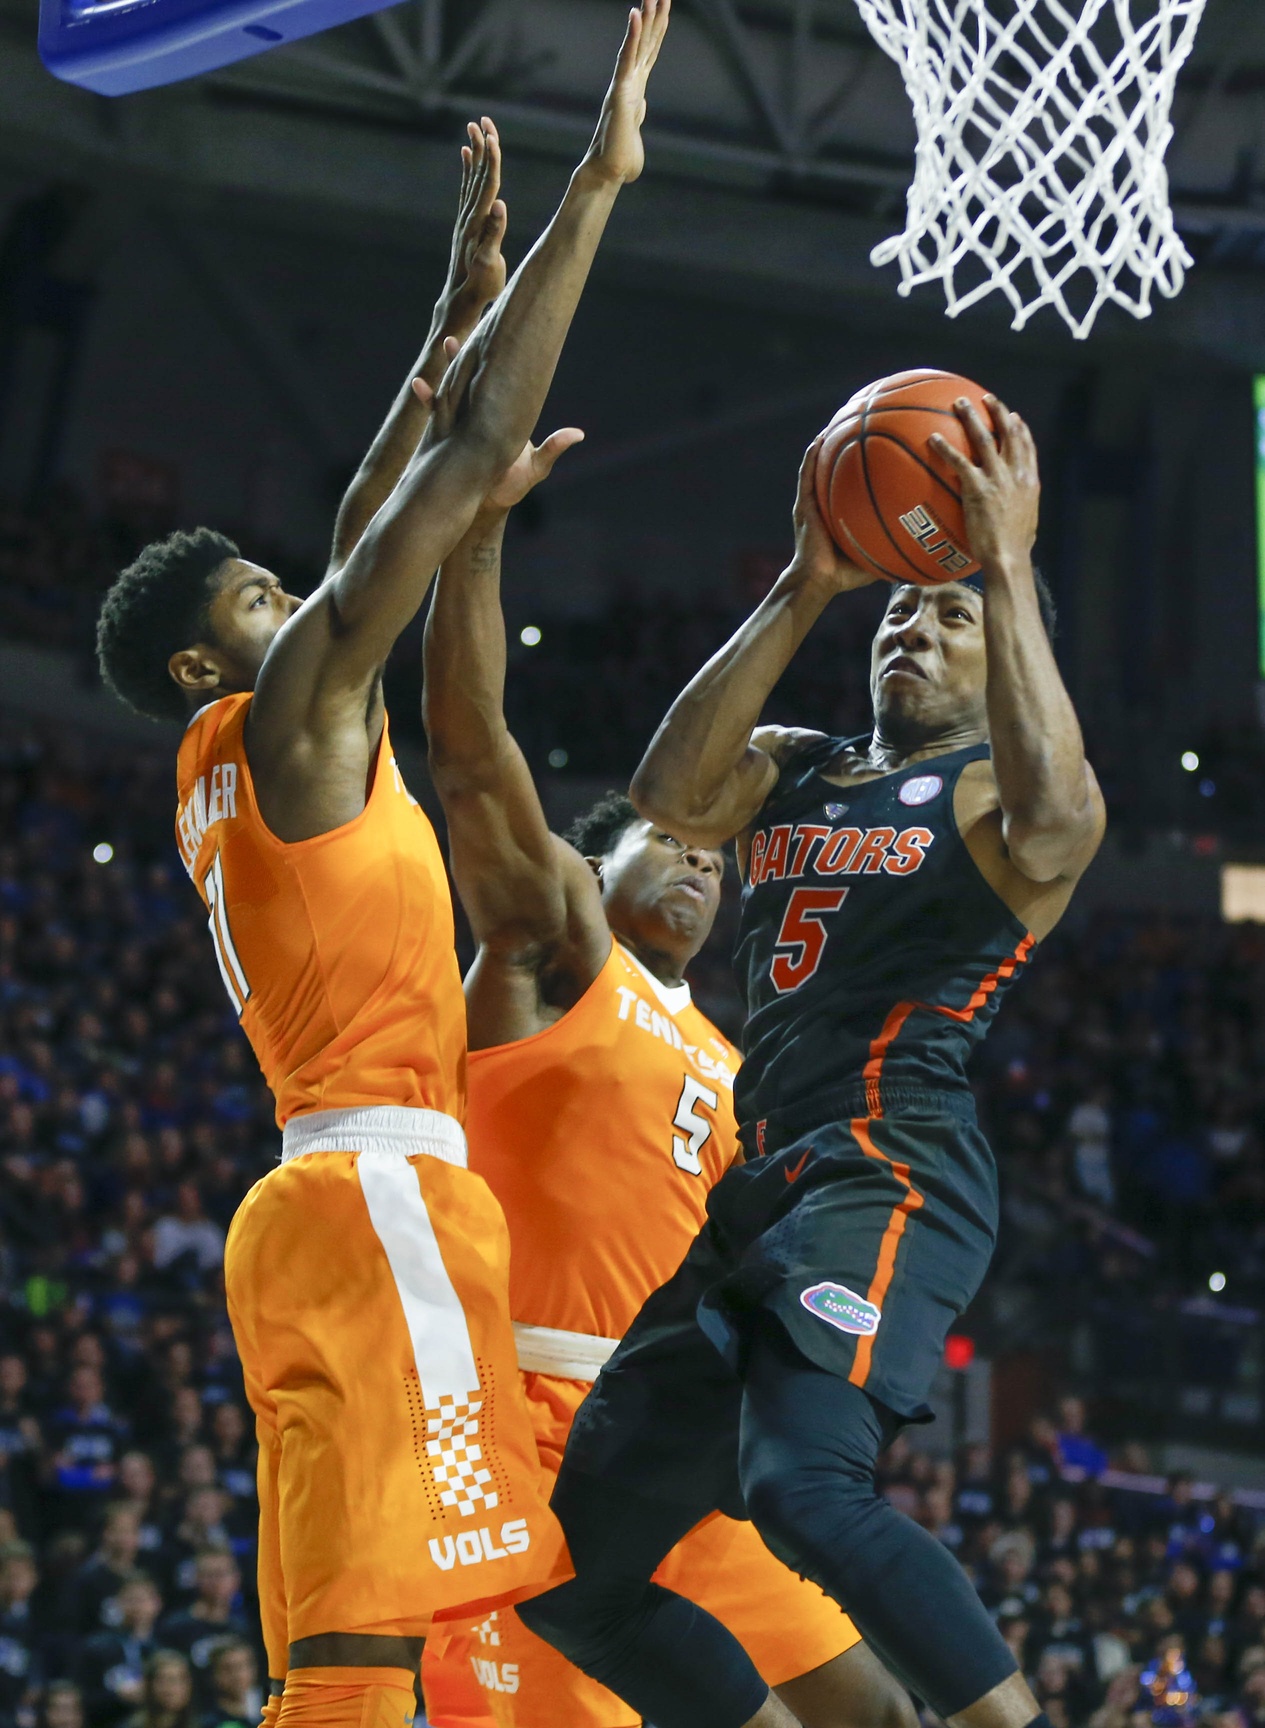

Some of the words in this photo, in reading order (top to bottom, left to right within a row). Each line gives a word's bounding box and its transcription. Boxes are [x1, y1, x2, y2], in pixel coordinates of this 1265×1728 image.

[750, 824, 935, 888] GATORS
[770, 887, 850, 994] 5
[672, 1072, 718, 1177] 5
[428, 1518, 530, 1571] VOLS
[470, 1656, 520, 1694] VOLS
